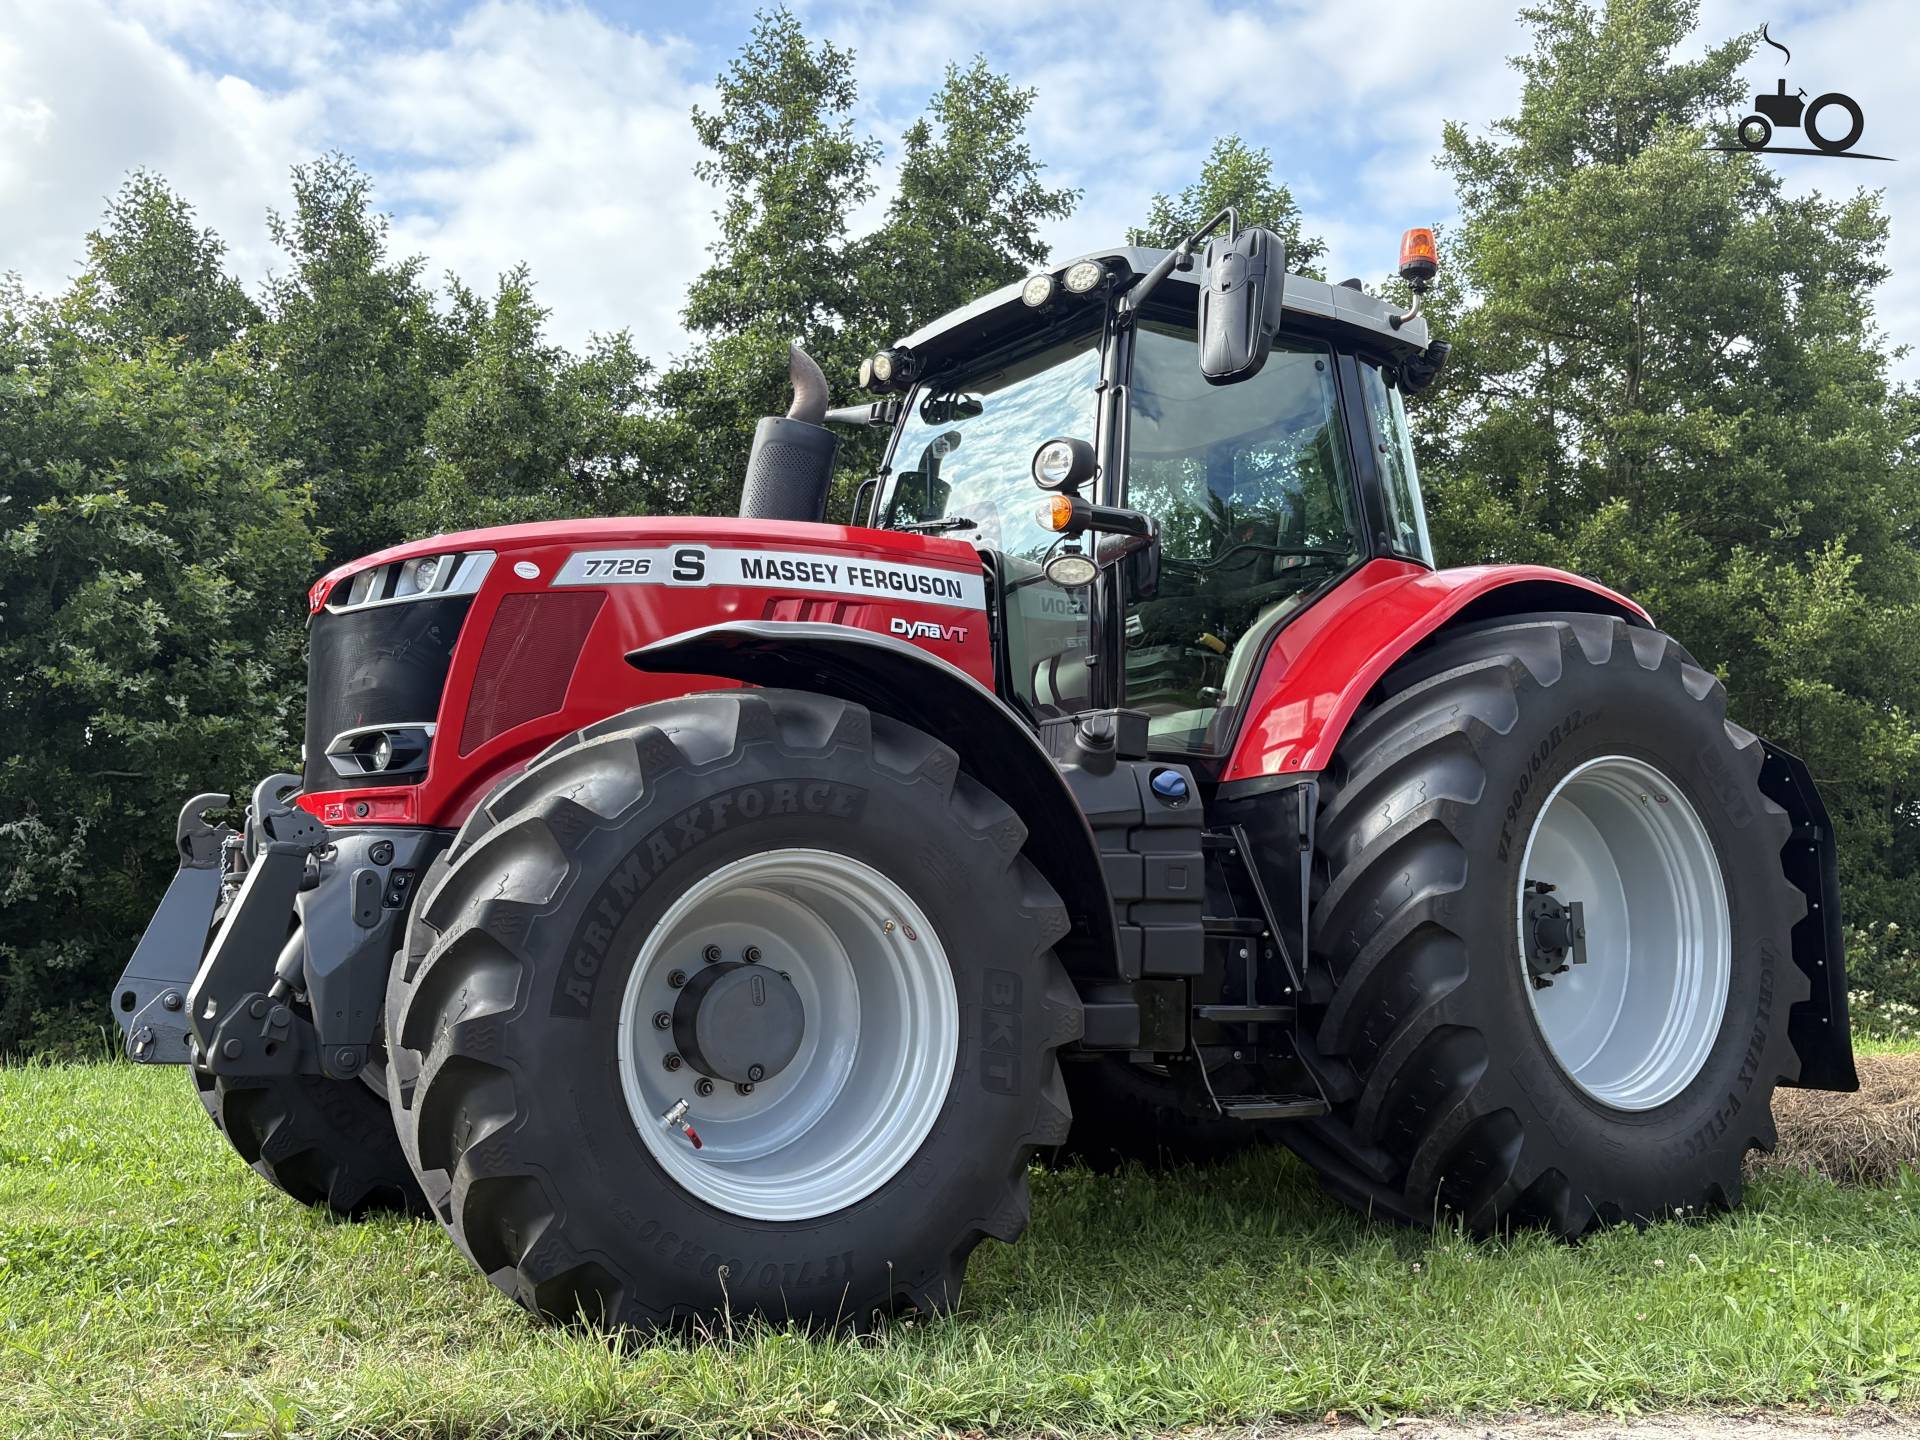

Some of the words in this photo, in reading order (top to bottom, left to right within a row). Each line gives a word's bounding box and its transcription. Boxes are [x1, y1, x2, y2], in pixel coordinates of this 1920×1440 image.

[585, 559, 652, 576] 7726
[673, 548, 706, 582] S
[740, 558, 838, 584] MASSEY
[846, 566, 963, 599] FERGUSON
[890, 617, 968, 643] DynaVT
[987, 981, 1017, 1090] BKT
